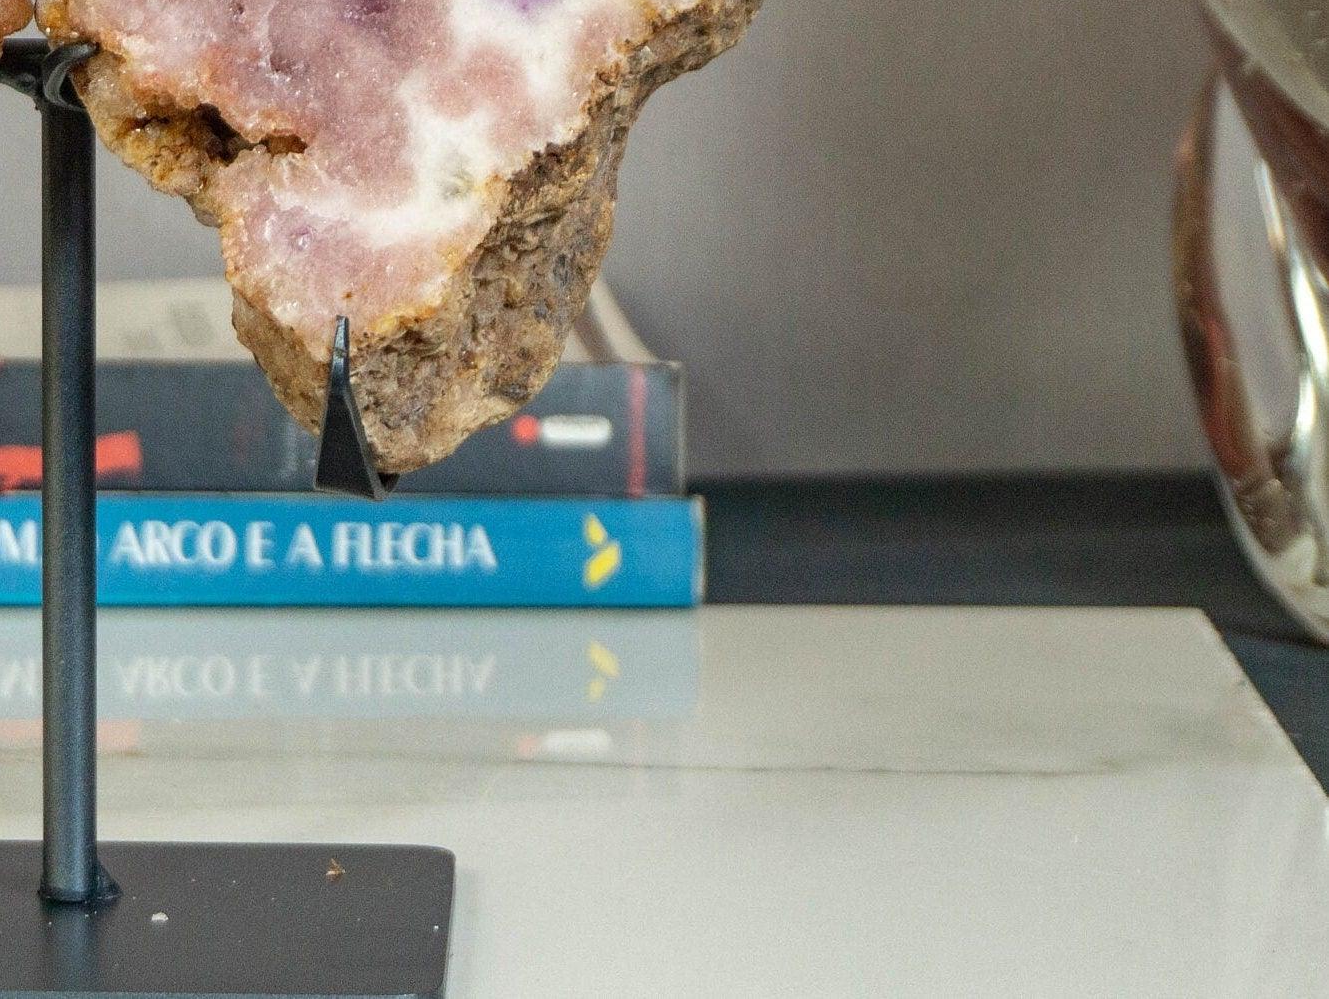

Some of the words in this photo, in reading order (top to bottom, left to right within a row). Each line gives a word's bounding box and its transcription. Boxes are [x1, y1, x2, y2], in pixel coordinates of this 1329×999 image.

[111, 519, 237, 568] ARCO
[246, 520, 274, 568] E
[286, 521, 324, 570] A
[332, 521, 499, 571] FLECHA
